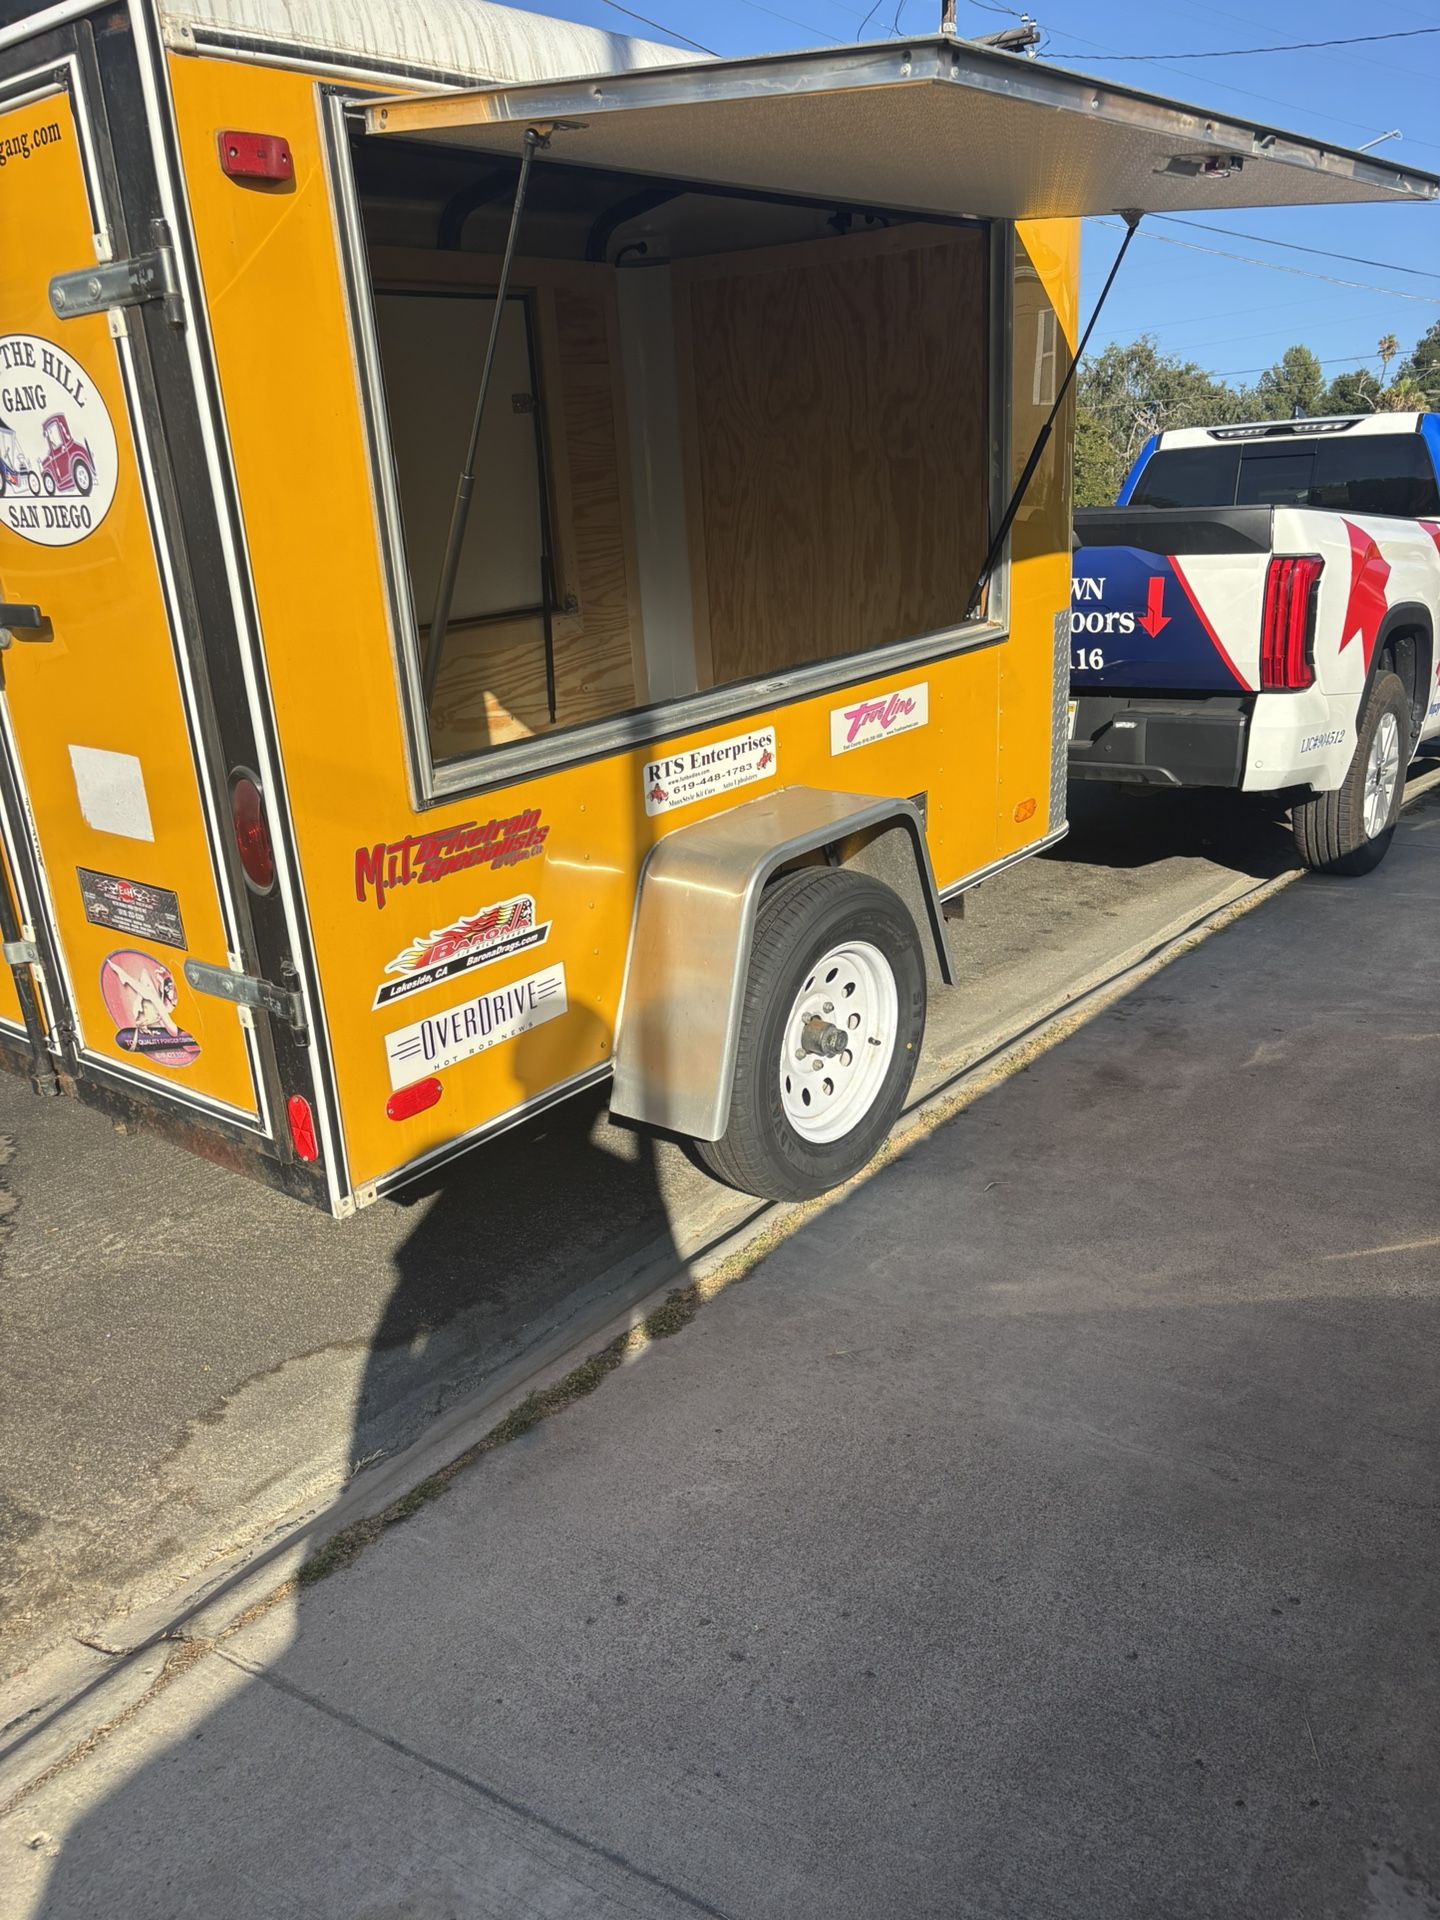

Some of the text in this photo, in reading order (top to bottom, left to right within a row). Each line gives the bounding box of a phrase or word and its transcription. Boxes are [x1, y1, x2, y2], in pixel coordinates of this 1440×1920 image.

[0, 341, 86, 409] THE HILL
[2, 384, 48, 413] GANG
[9, 504, 92, 529] SAN DIEGO
[1071, 611, 1136, 634] oors
[1070, 648, 1104, 670] 16
[648, 734, 772, 783] RTS Enterprises
[673, 763, 753, 794] 619-448-1783
[412, 808, 542, 866] Drivetrain
[417, 825, 551, 884] Specialists
[428, 902, 531, 965] BARONA
[389, 933, 538, 997] Lakeside, CA BaronaDrags.com
[434, 1022, 533, 1070] HOT ROD NEWS
